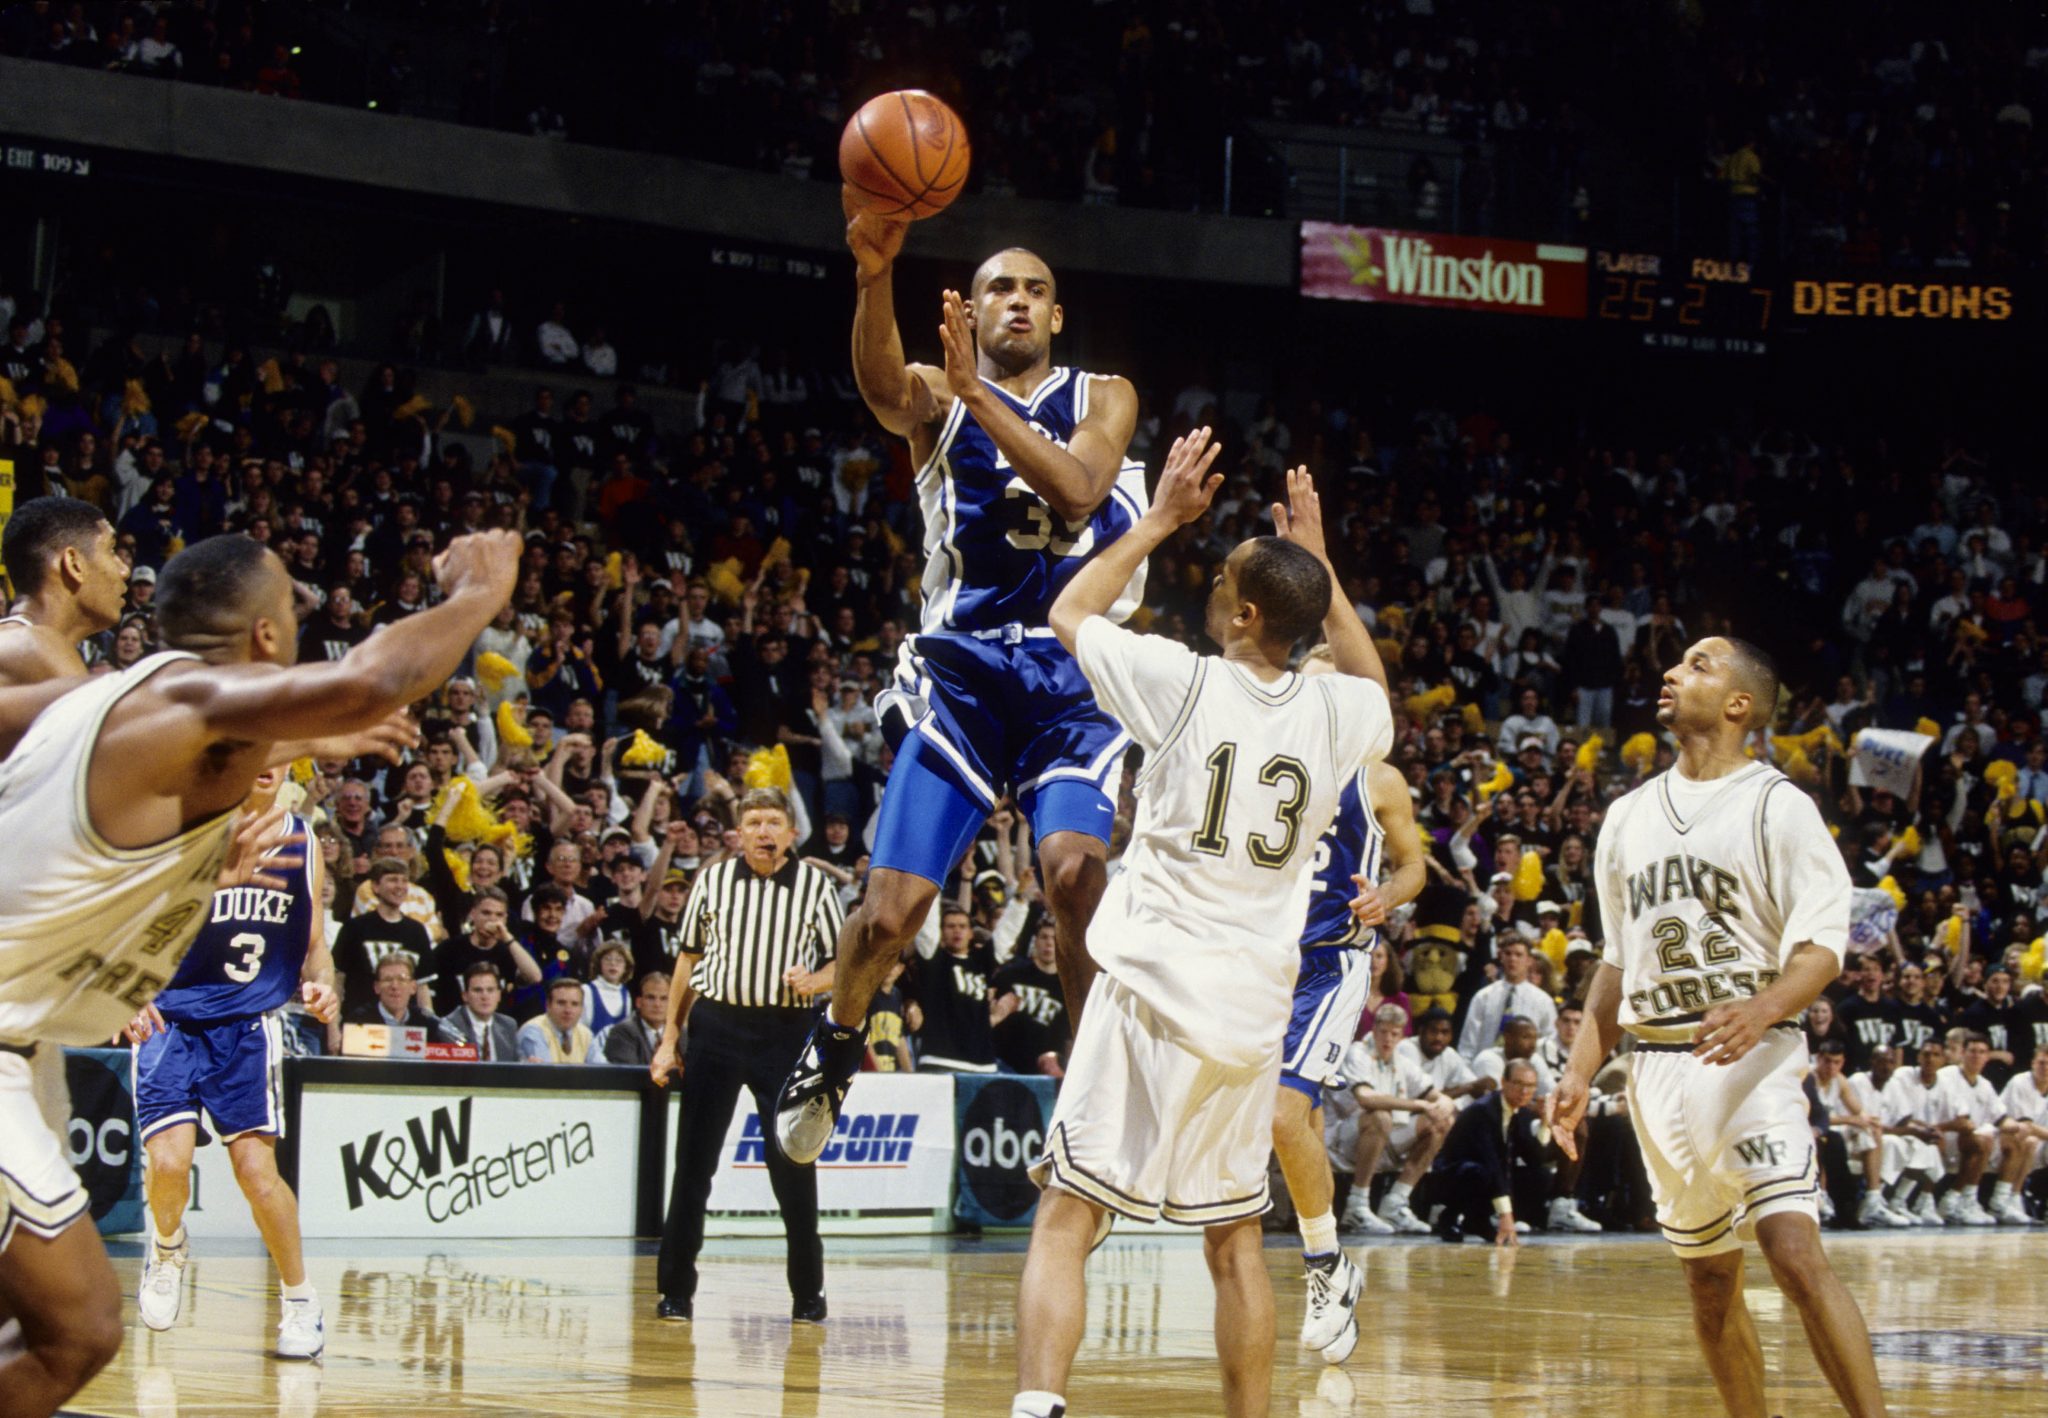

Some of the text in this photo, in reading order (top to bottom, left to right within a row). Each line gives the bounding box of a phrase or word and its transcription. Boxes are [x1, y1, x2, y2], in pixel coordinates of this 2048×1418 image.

[42, 153, 72, 173] 109
[1383, 235, 1546, 305] Winston
[1596, 251, 1751, 284] PLAYER FOULS
[1793, 280, 2013, 320] DEACONS
[1191, 742, 1311, 870] 13
[211, 887, 294, 924] DUKE
[1627, 853, 1742, 921] WAKE
[224, 932, 266, 982] 3
[1651, 914, 1741, 973] 22
[1012, 984, 1062, 1026] WF
[1630, 969, 1780, 1015] FOREST
[1855, 1019, 1896, 1048] WF
[340, 1095, 473, 1211] K&W
[964, 1116, 1043, 1169] abc
[1733, 1133, 1787, 1166] WF
[426, 1121, 595, 1223] cafeteria
